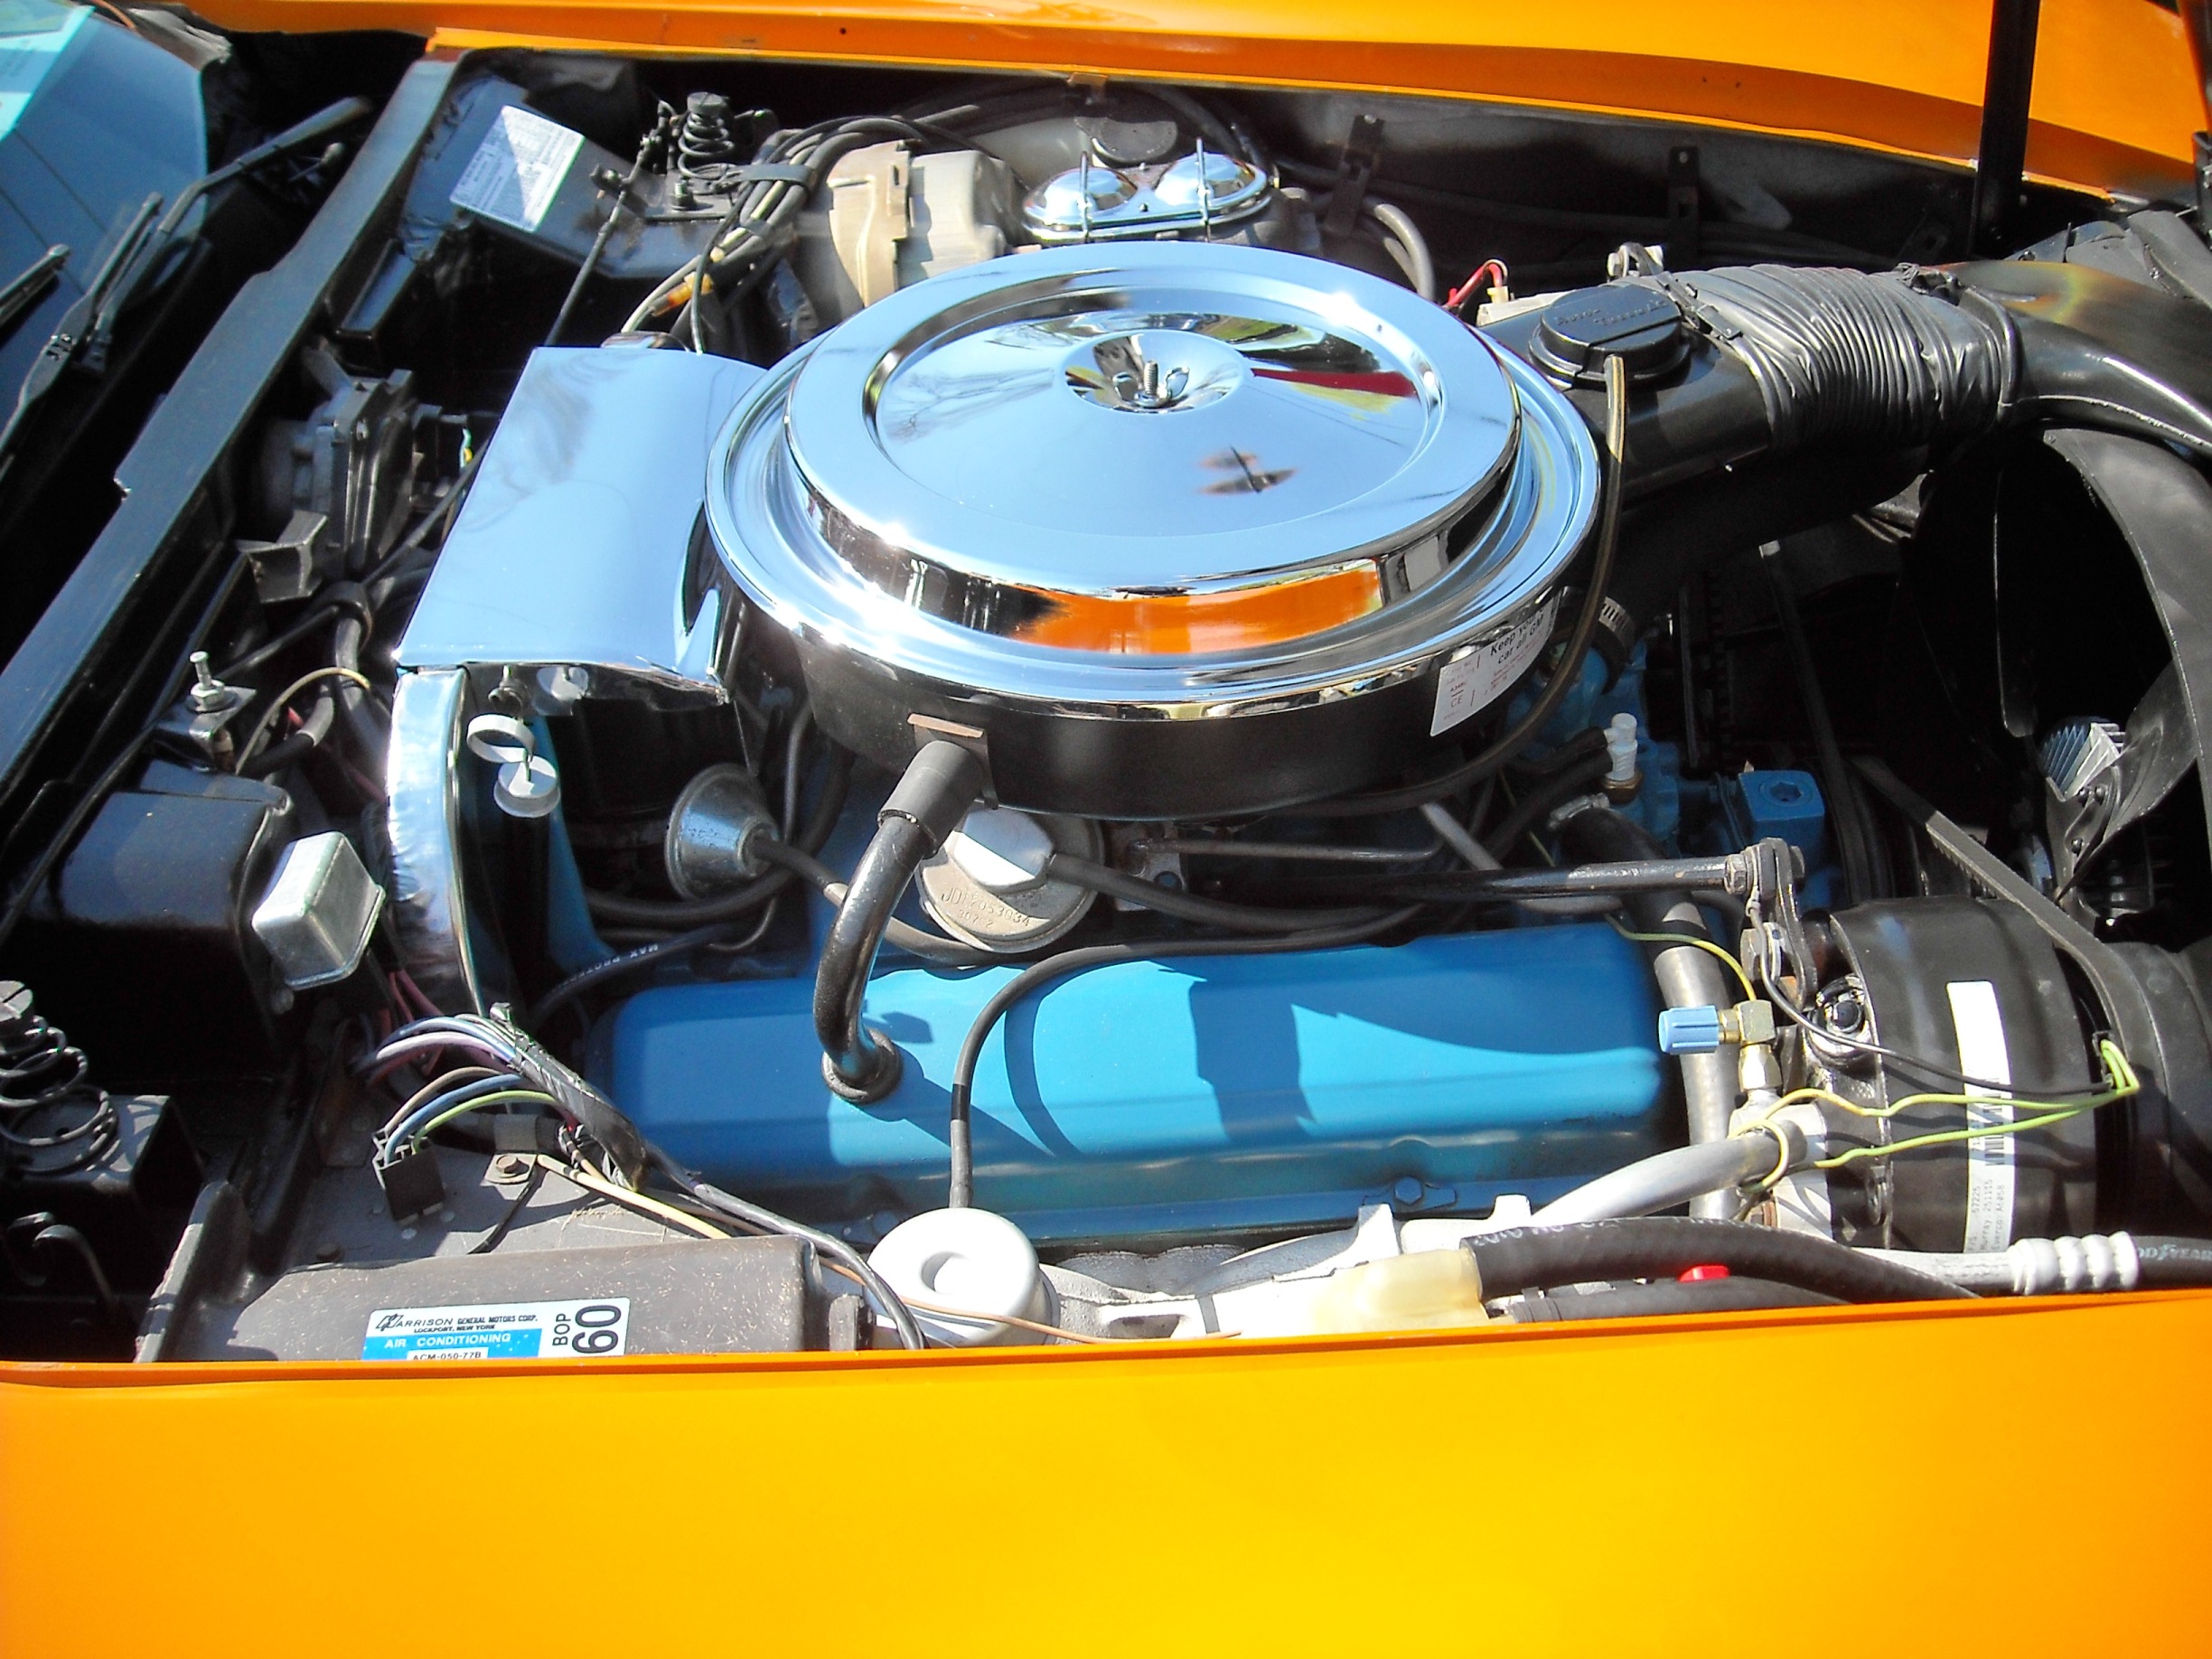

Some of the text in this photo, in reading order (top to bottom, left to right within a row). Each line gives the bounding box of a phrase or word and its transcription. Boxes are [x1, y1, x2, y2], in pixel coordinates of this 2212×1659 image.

[1491, 633, 1515, 656] Keep
[1498, 646, 1514, 663] car
[1516, 633, 1527, 649] all
[1529, 614, 1543, 635] GM
[630, 943, 659, 959] MAX
[457, 1317, 485, 1325] GENERAL
[518, 1314, 538, 1322] CORP.
[552, 1313, 571, 1346] BOP
[571, 1305, 622, 1354] 60
[384, 1333, 511, 1348] AIR CONDITIONING
